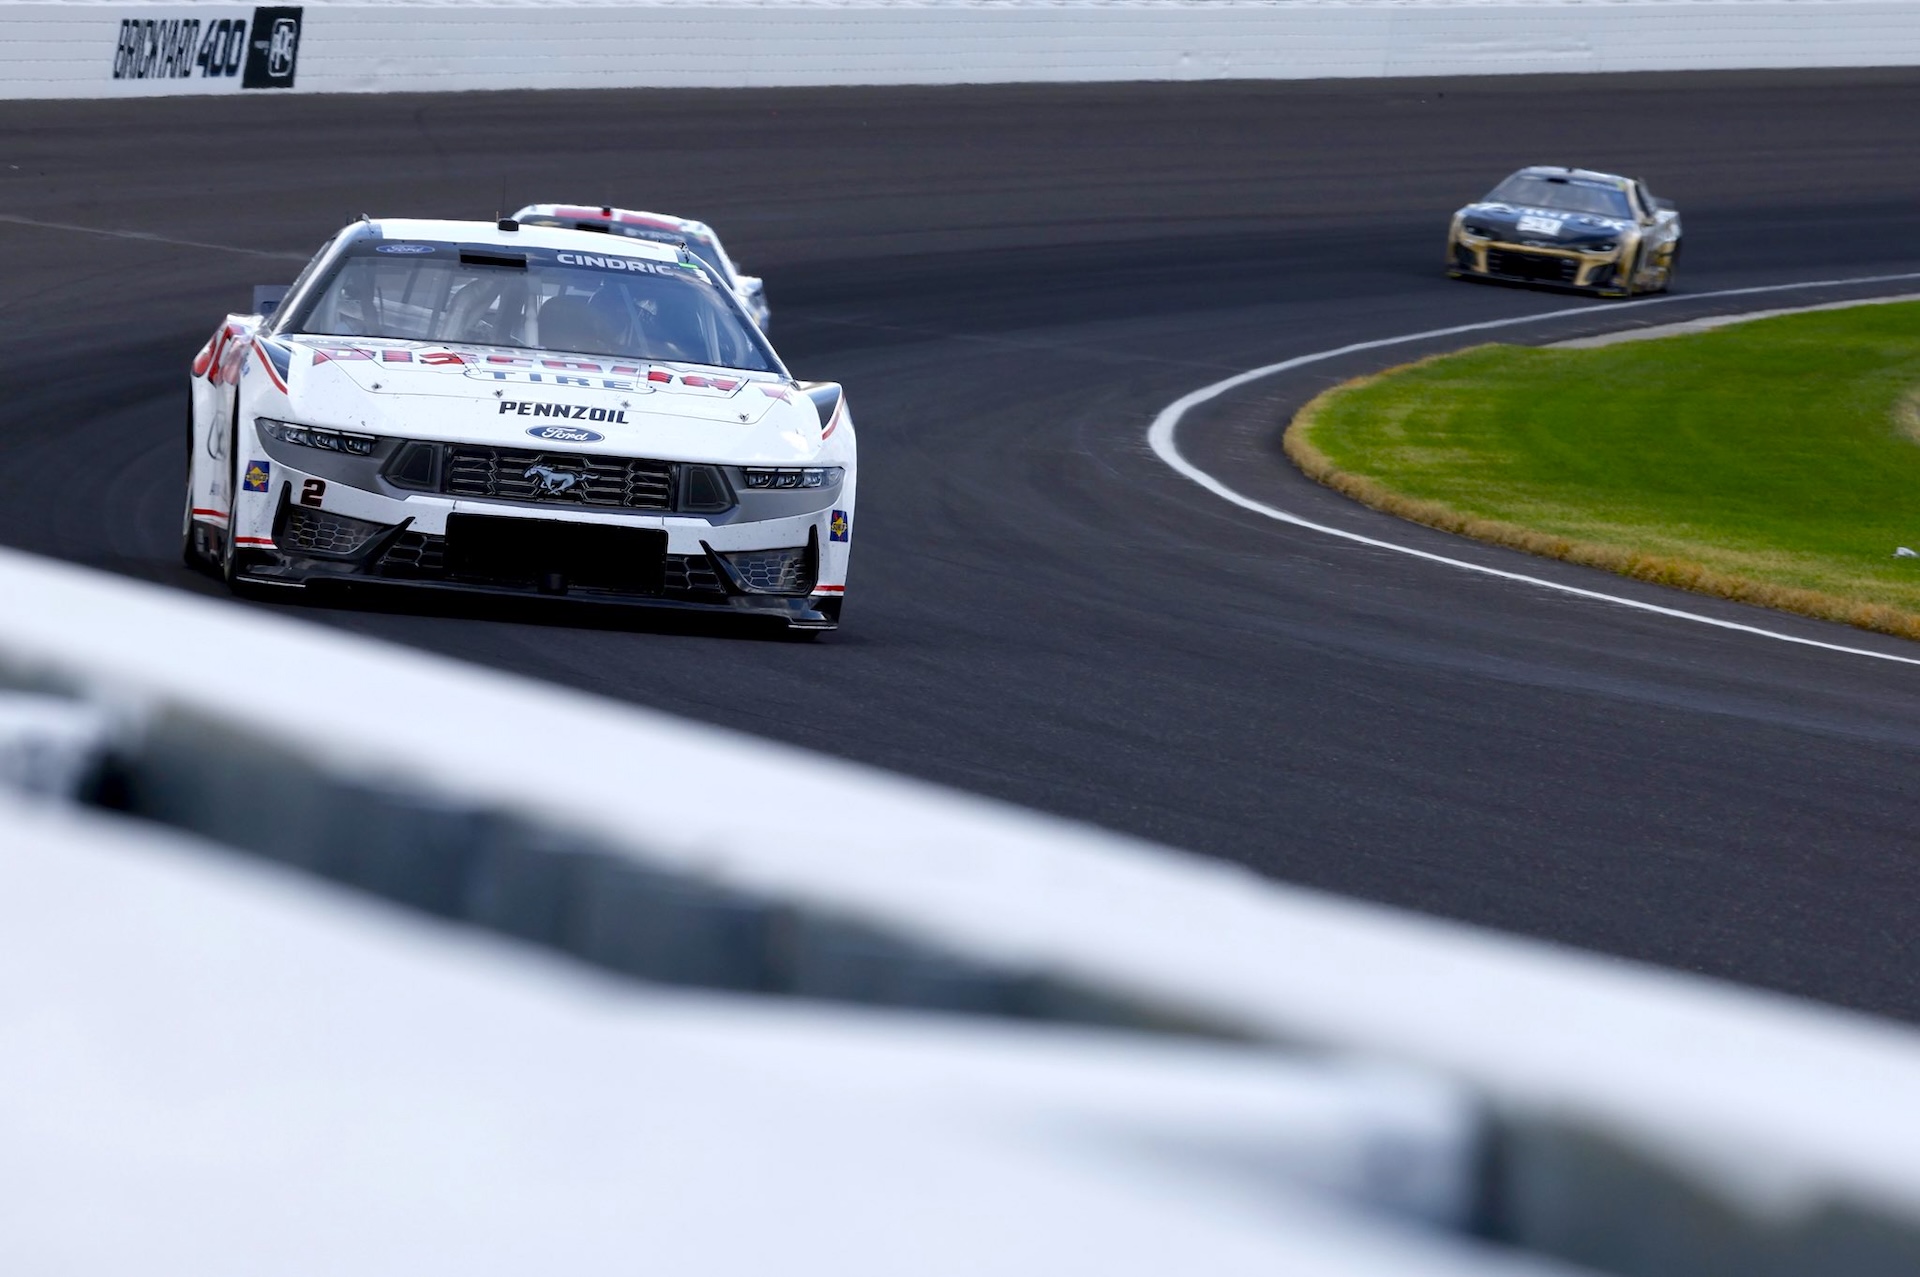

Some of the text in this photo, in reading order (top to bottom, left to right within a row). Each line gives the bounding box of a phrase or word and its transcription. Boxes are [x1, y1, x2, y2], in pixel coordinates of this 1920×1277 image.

[113, 18, 201, 79] BRICKYARD
[197, 18, 247, 78] 400
[557, 253, 675, 276] CINDRIC
[480, 370, 634, 391] TIRE
[499, 401, 629, 424] PENNZOIL
[300, 479, 326, 508] 2
